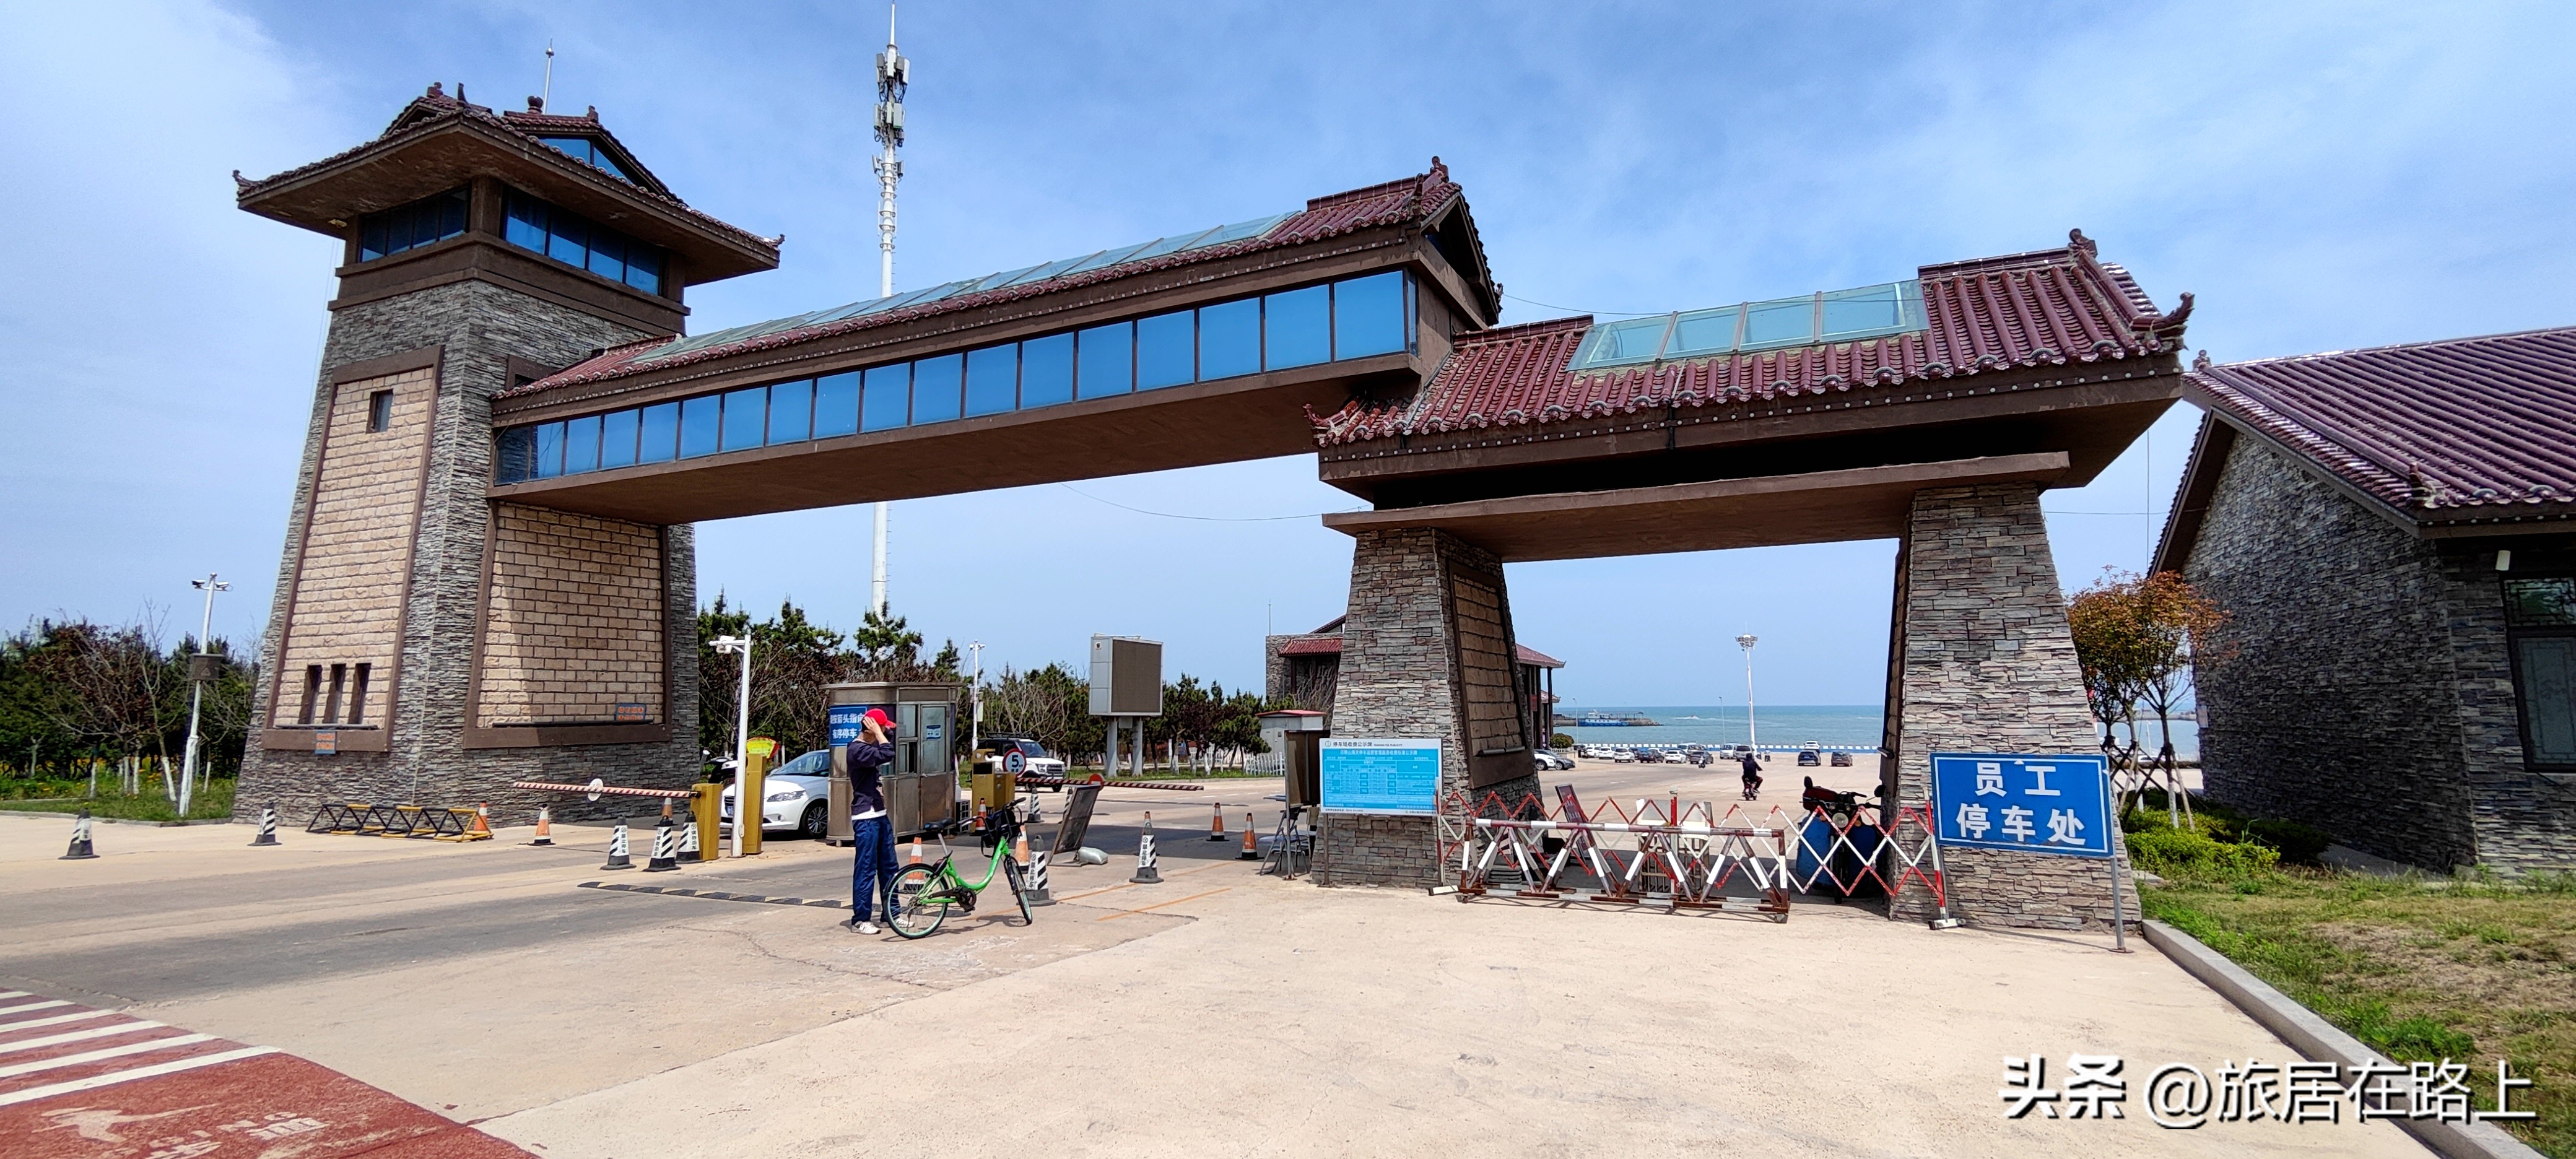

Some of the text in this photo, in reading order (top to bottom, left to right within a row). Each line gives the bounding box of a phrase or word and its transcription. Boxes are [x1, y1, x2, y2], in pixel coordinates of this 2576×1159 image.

[832, 728, 861, 739] 有序停车
[1011, 755, 1019, 768] 5
[1975, 763, 2061, 797] 员工
[1956, 803, 2086, 845] 停车处
